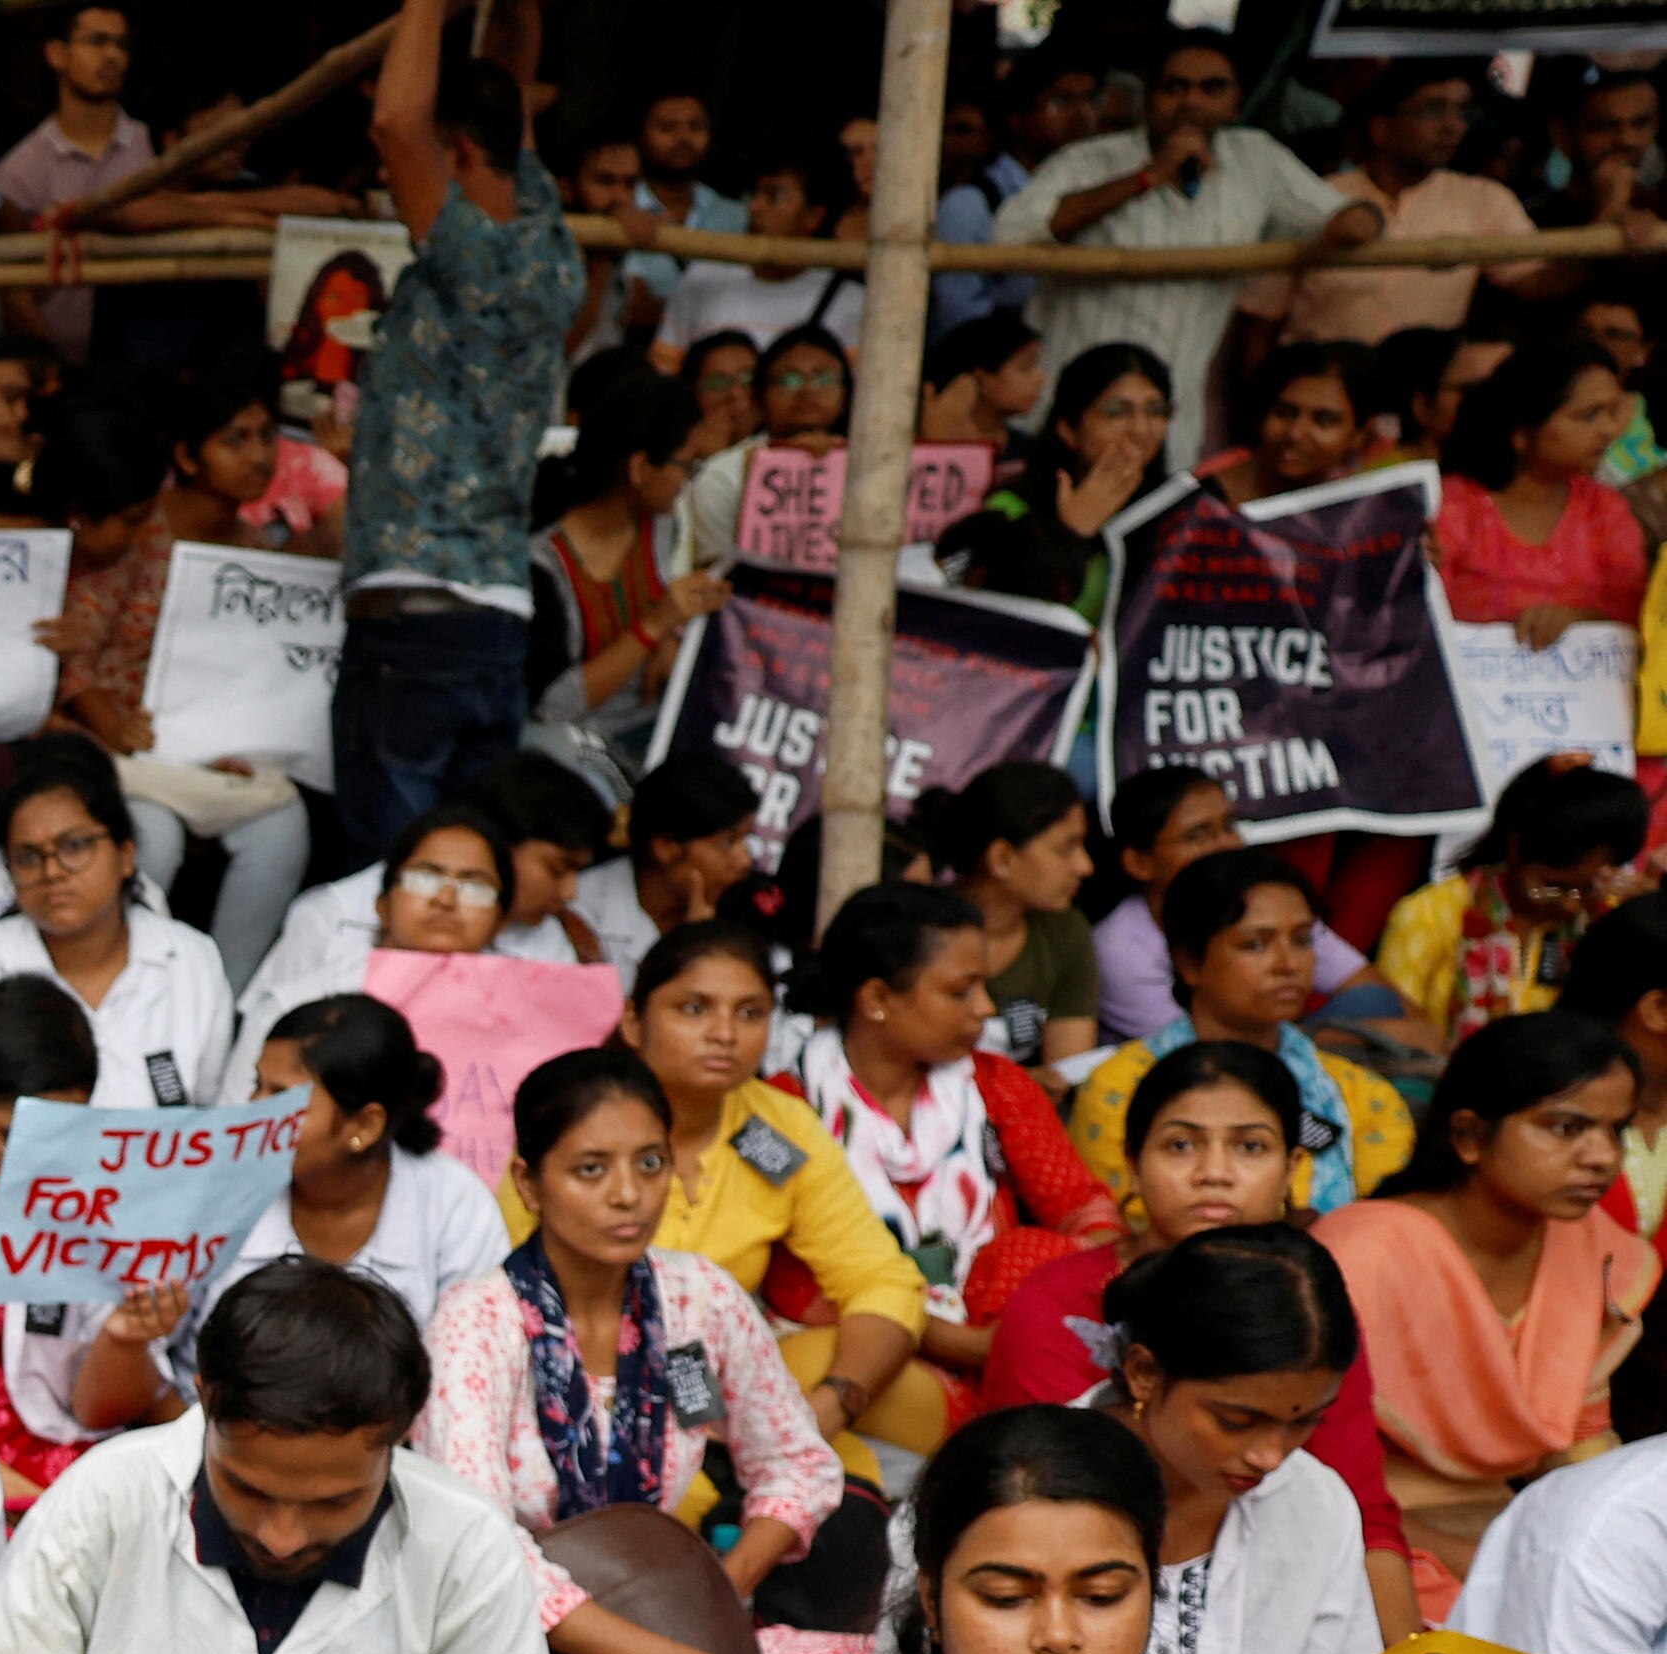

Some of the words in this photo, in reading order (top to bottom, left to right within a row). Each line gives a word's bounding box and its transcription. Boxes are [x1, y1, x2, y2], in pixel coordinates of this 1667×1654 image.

[759, 463, 827, 515] SHE
[1149, 625, 1334, 688] JUSTICE
[1145, 689, 1244, 747] FOR
[99, 1109, 307, 1173] JUSTICE
[24, 1177, 120, 1226] FOR
[0, 1231, 228, 1285] VICTIMS
